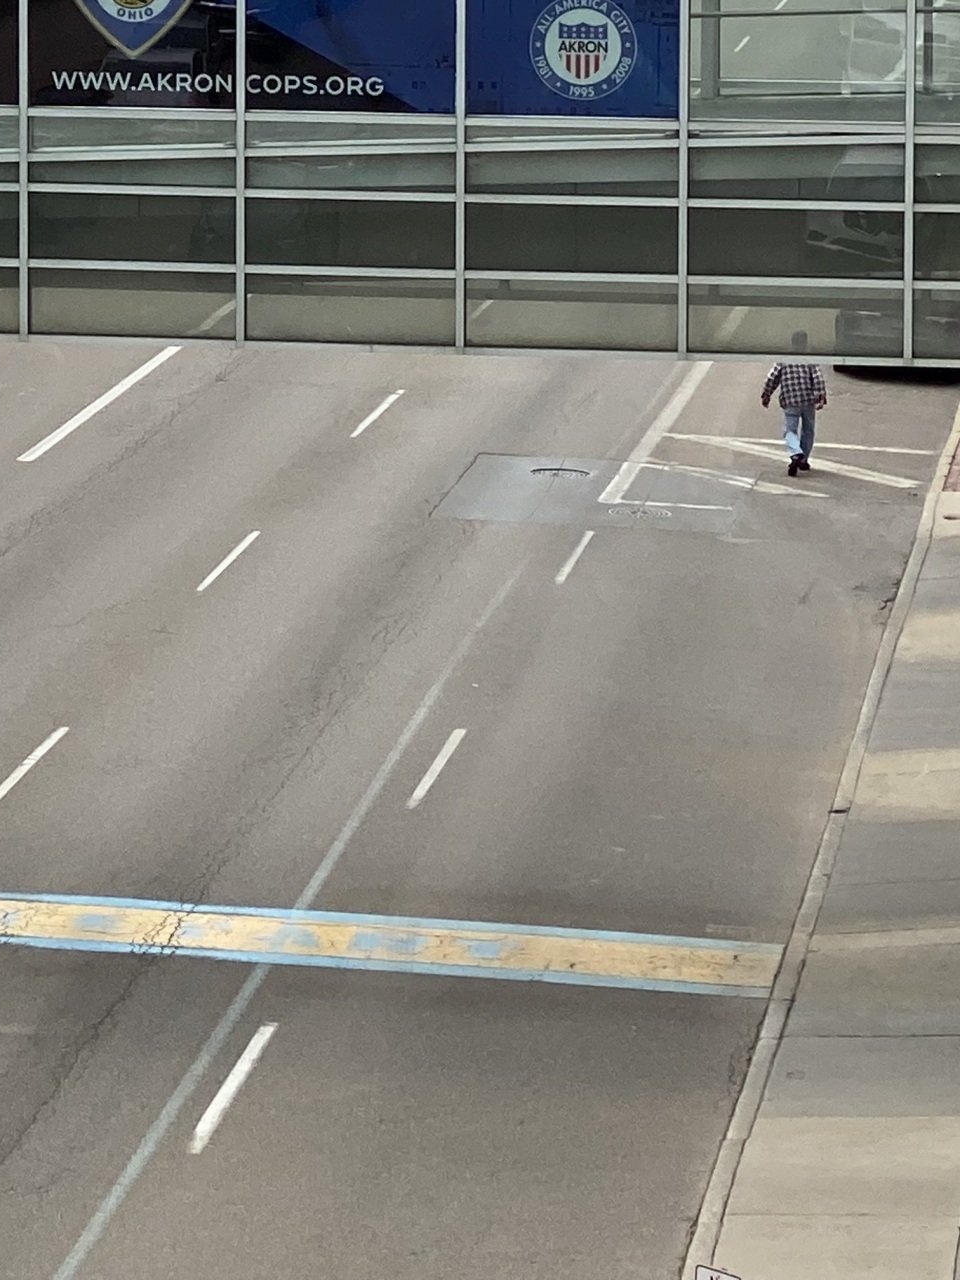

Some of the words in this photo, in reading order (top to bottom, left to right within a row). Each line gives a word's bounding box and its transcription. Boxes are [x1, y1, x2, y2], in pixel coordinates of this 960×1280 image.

[117, 8, 154, 20] OHIO
[610, 10, 631, 34] CITY
[558, 40, 608, 53] AKRON
[51, 71, 385, 96] WWW.AKRONCOPS.ORG
[569, 85, 595, 97] 1995
[611, 57, 632, 83] 2008
